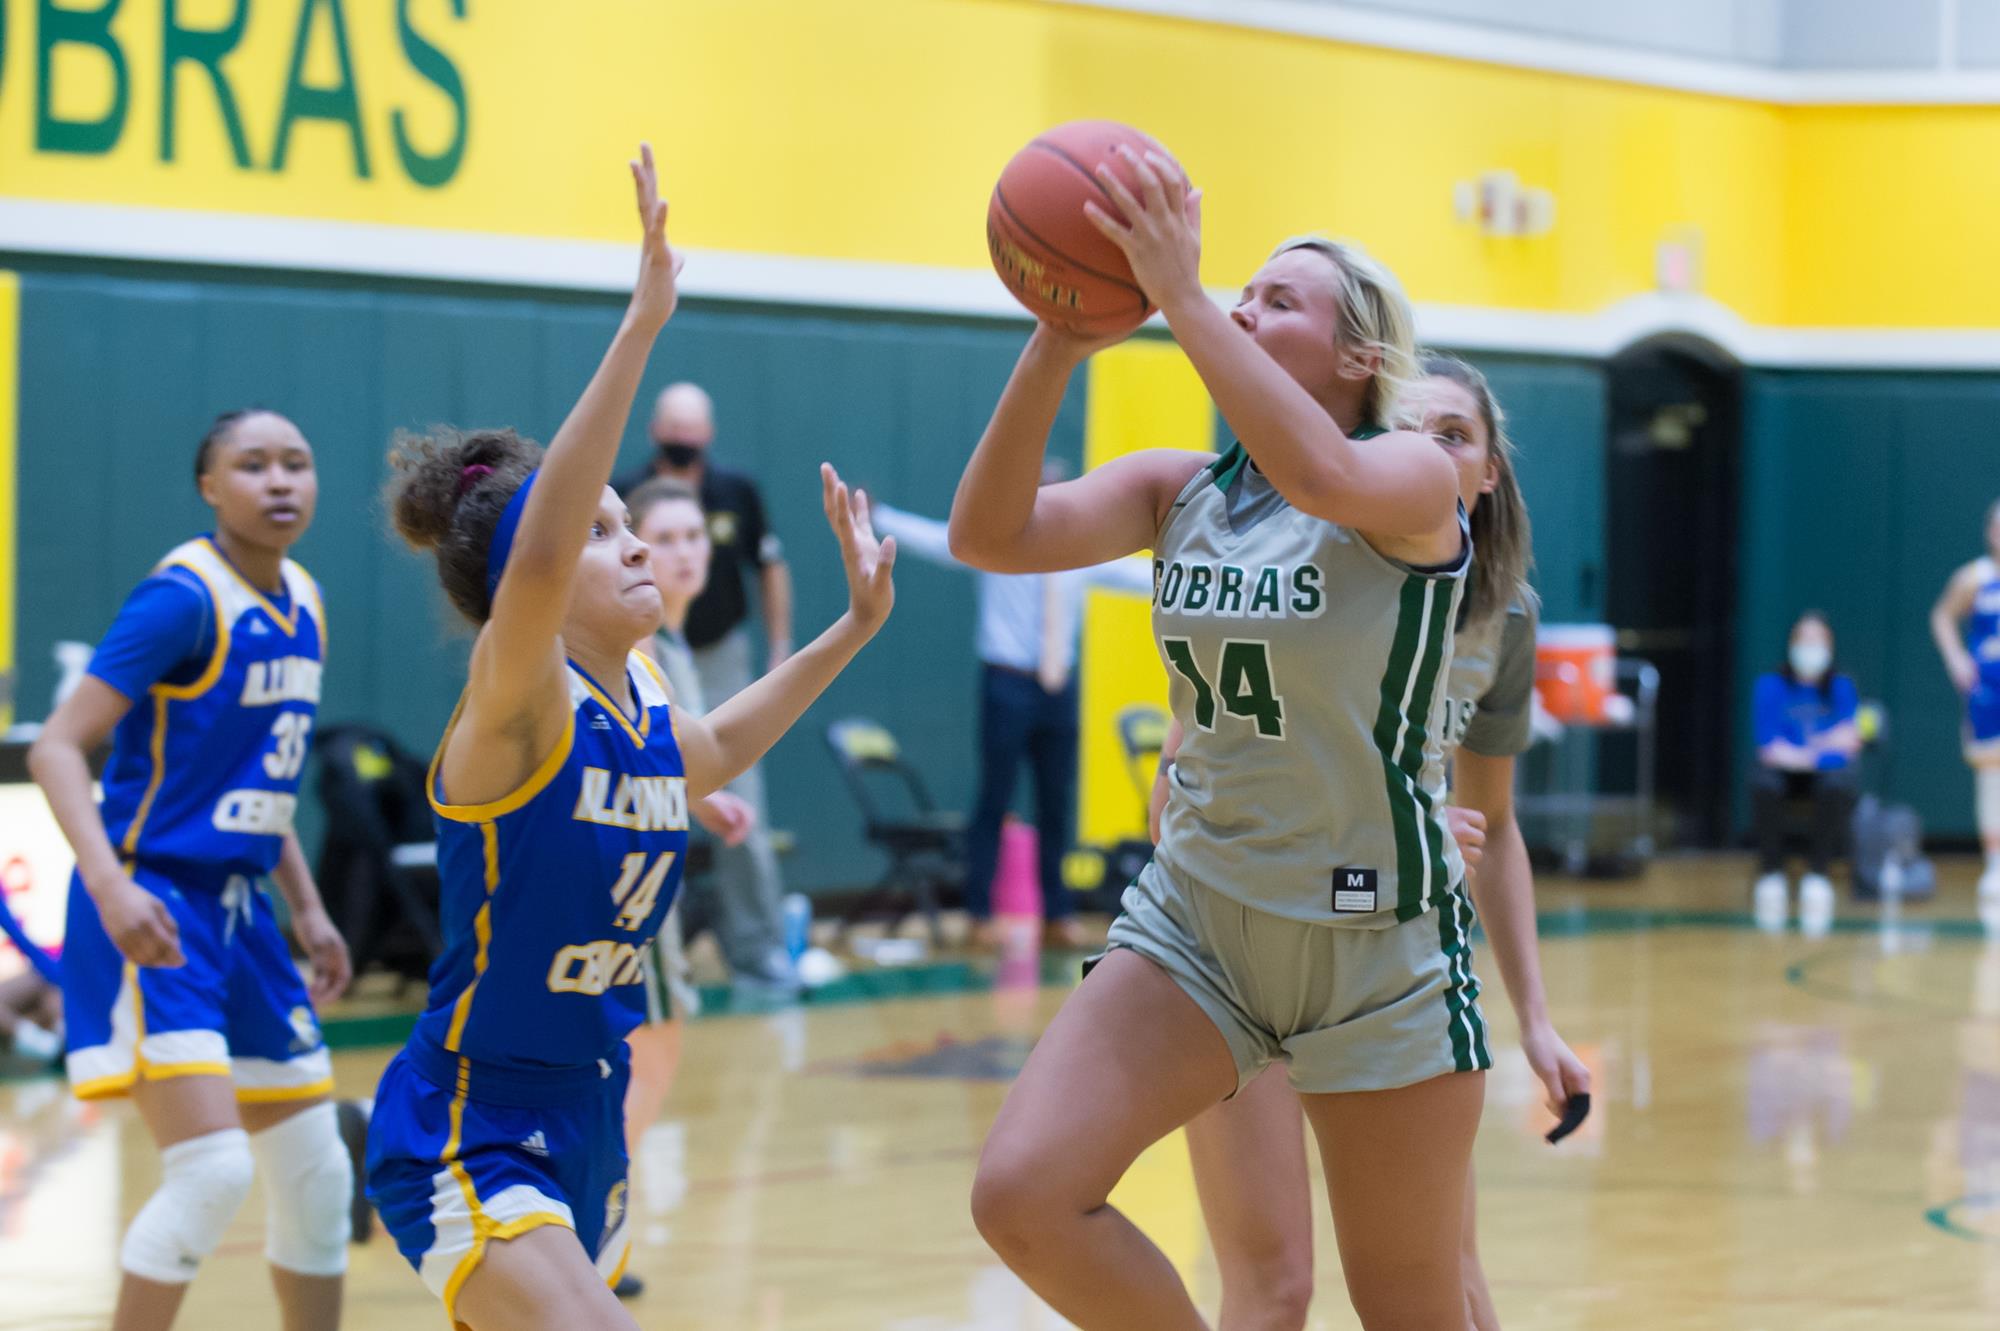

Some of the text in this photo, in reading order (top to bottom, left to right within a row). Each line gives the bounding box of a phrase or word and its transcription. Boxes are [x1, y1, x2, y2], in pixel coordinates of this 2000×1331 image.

[0, 0, 468, 189] BRAS
[1152, 557, 1326, 618] COBRAS
[1160, 635, 1286, 741] 14
[609, 852, 676, 931] 14
[1347, 873, 1364, 887] M
